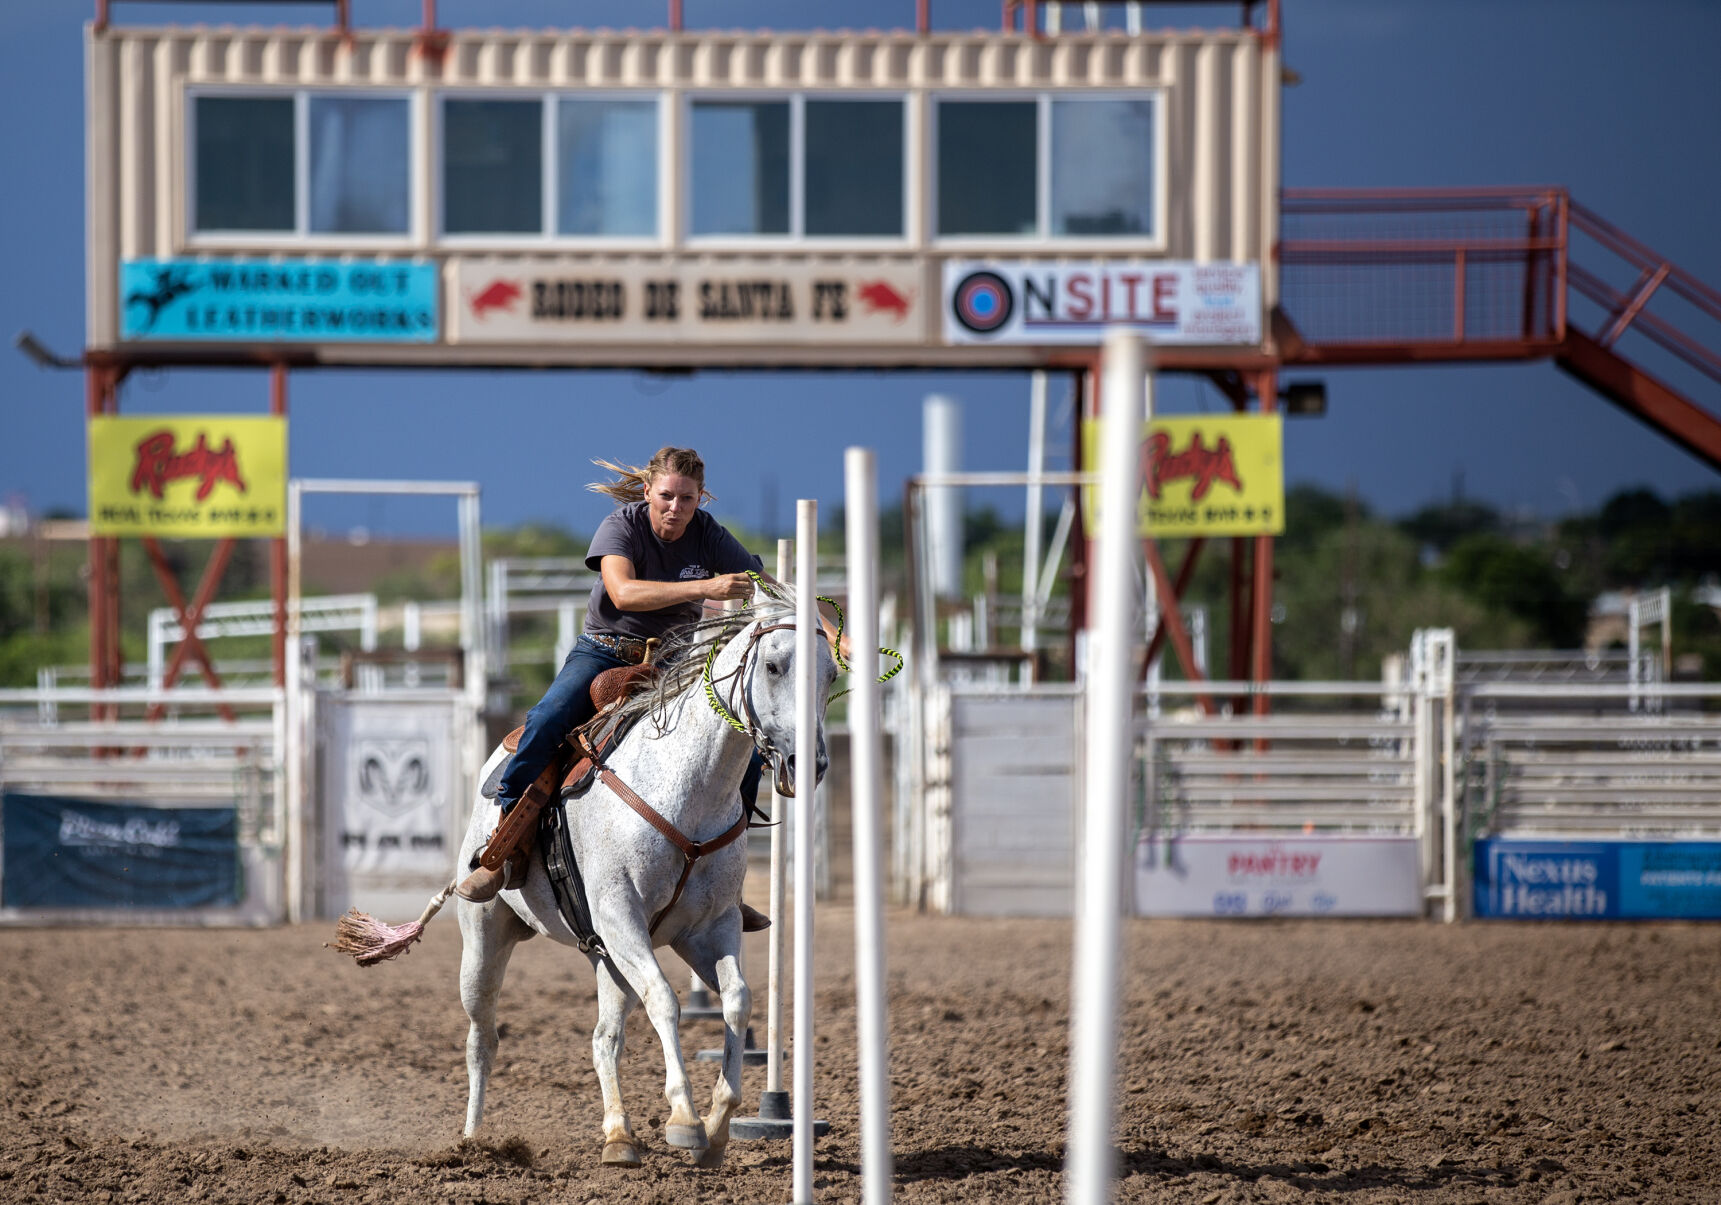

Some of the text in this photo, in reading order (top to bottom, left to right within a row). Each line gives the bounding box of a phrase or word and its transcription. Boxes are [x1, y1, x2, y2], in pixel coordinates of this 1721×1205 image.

[530, 279, 849, 323] RODEO DE SANTA FE
[1227, 853, 1322, 875] PANTRY
[1503, 853, 1598, 884] Nexus
[1503, 885, 1606, 914] Health
